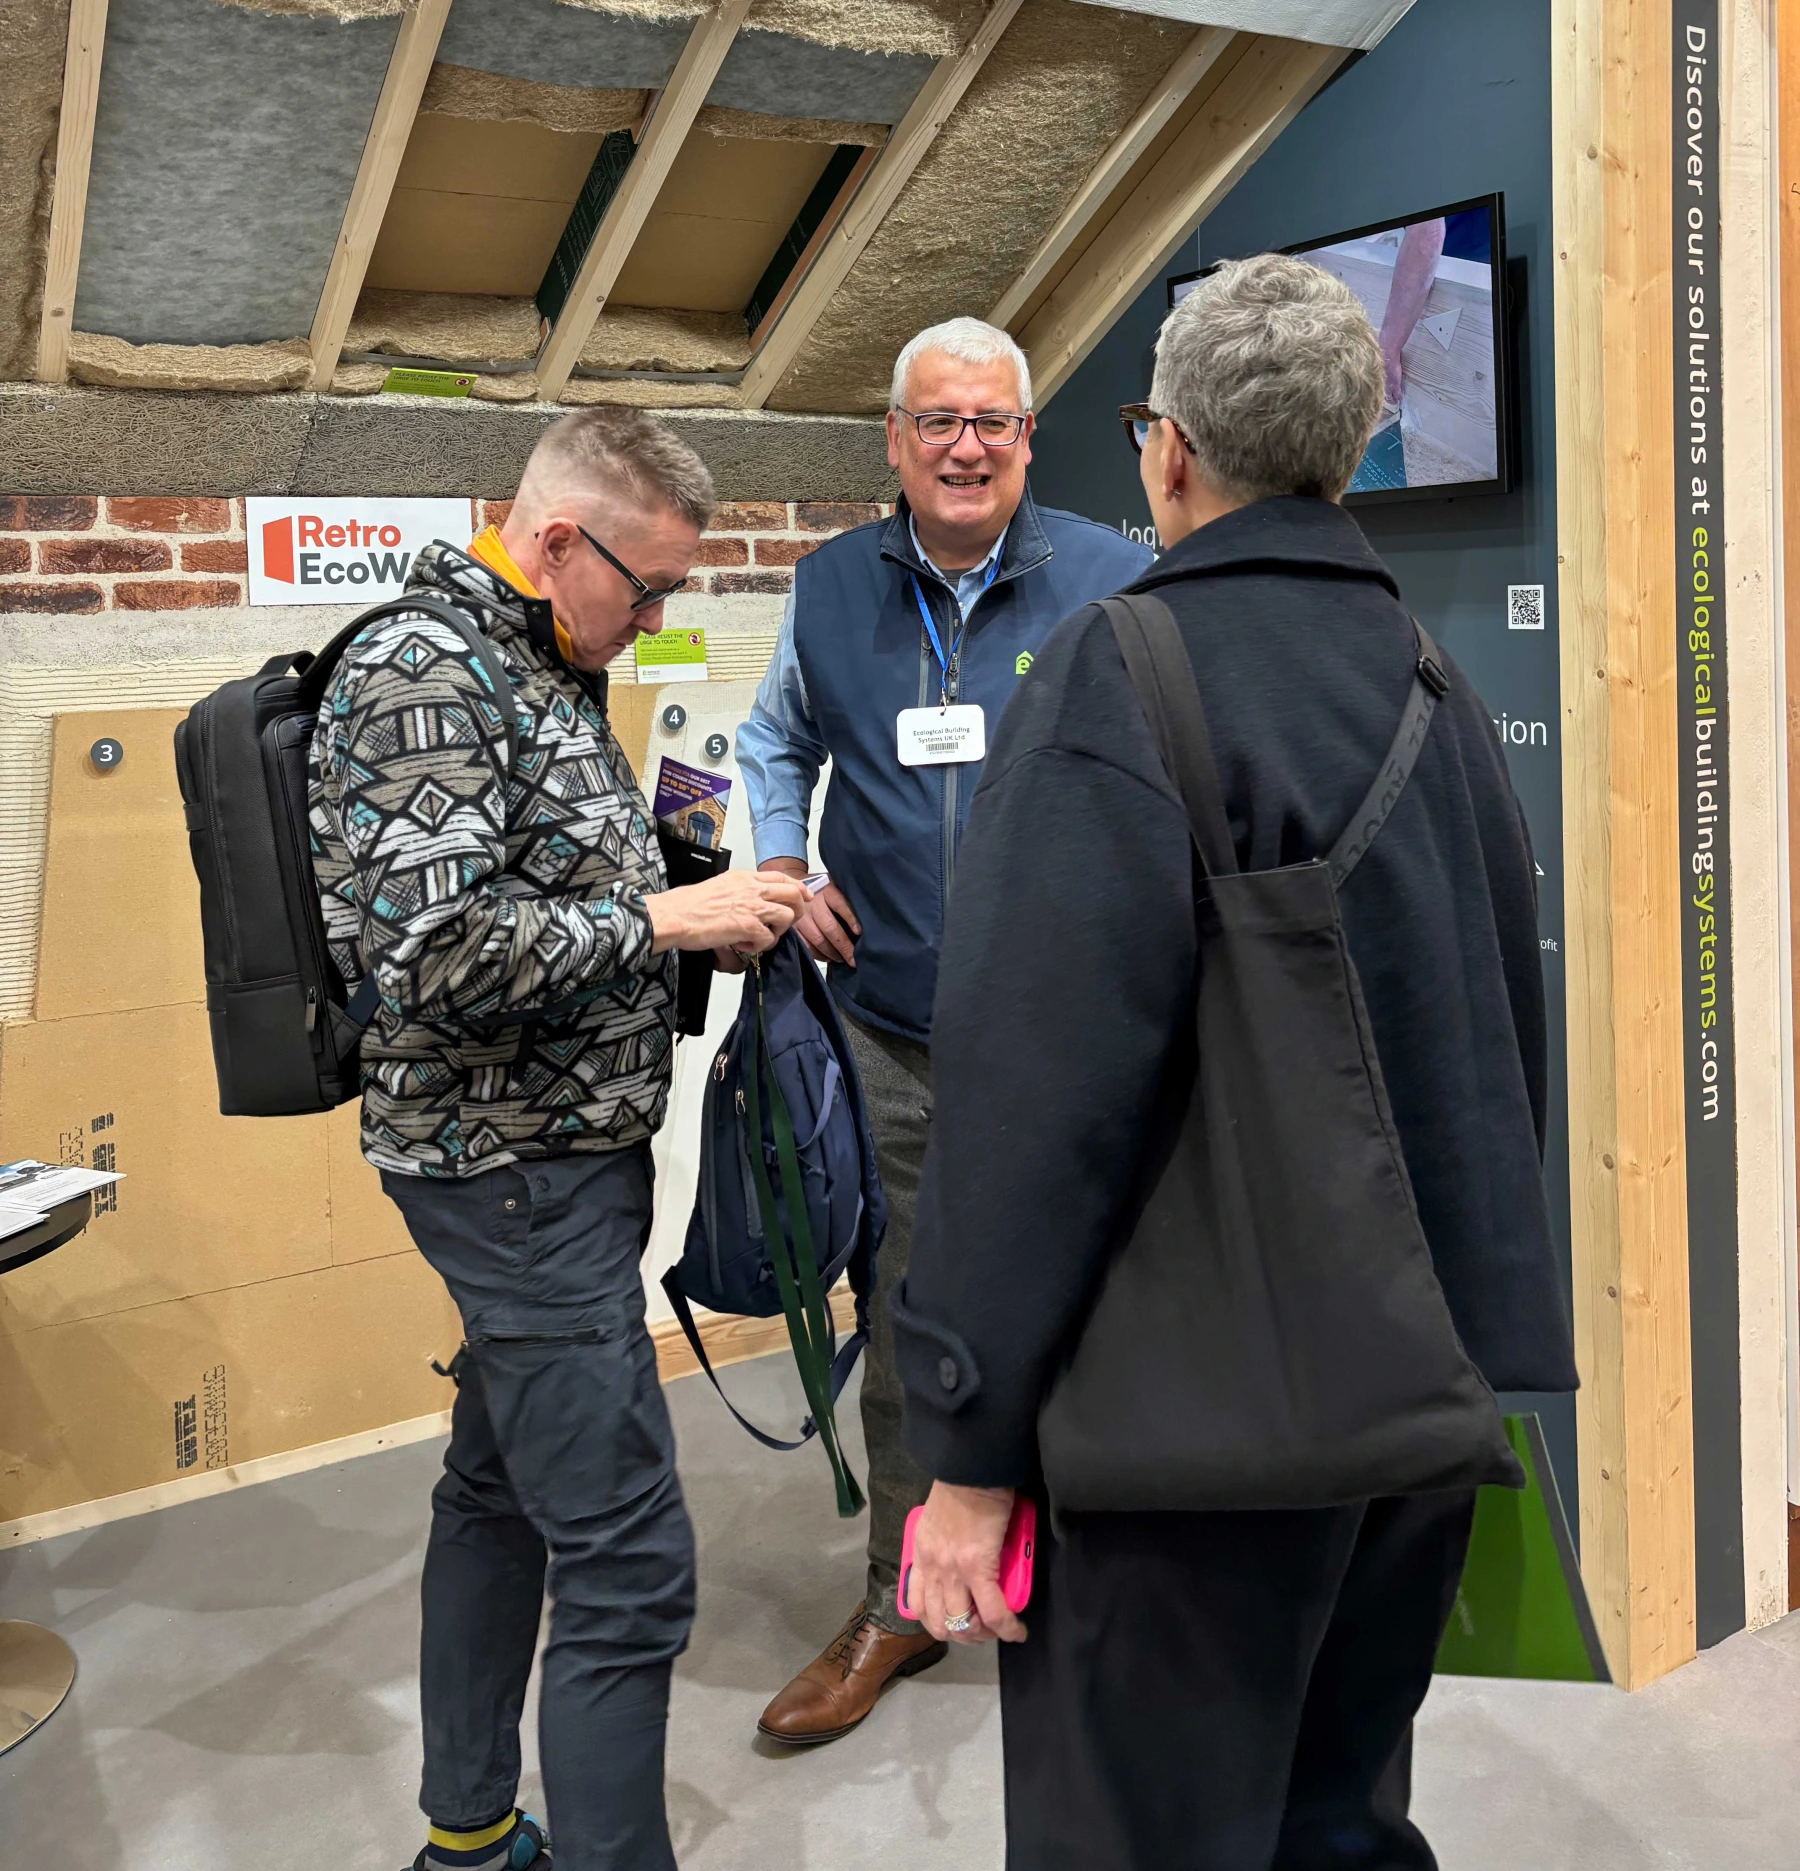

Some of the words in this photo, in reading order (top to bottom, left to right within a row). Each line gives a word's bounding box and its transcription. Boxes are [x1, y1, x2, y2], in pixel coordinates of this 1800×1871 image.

[1686, 24, 1707, 196] Discover
[1687, 206, 1704, 276] our
[1688, 285, 1711, 465] solutions
[1690, 476, 1711, 516] at
[298, 515, 402, 548] Retro
[669, 709, 679, 725] 4
[913, 728, 944, 736] Ecological
[1493, 712, 1547, 746] ion
[100, 743, 113, 763] 3
[712, 738, 722, 754] 5
[918, 736, 943, 744] Systems
[1688, 526, 1720, 1121] ecologicalbuildingsystems.com
[1537, 937, 1558, 952] ofit
